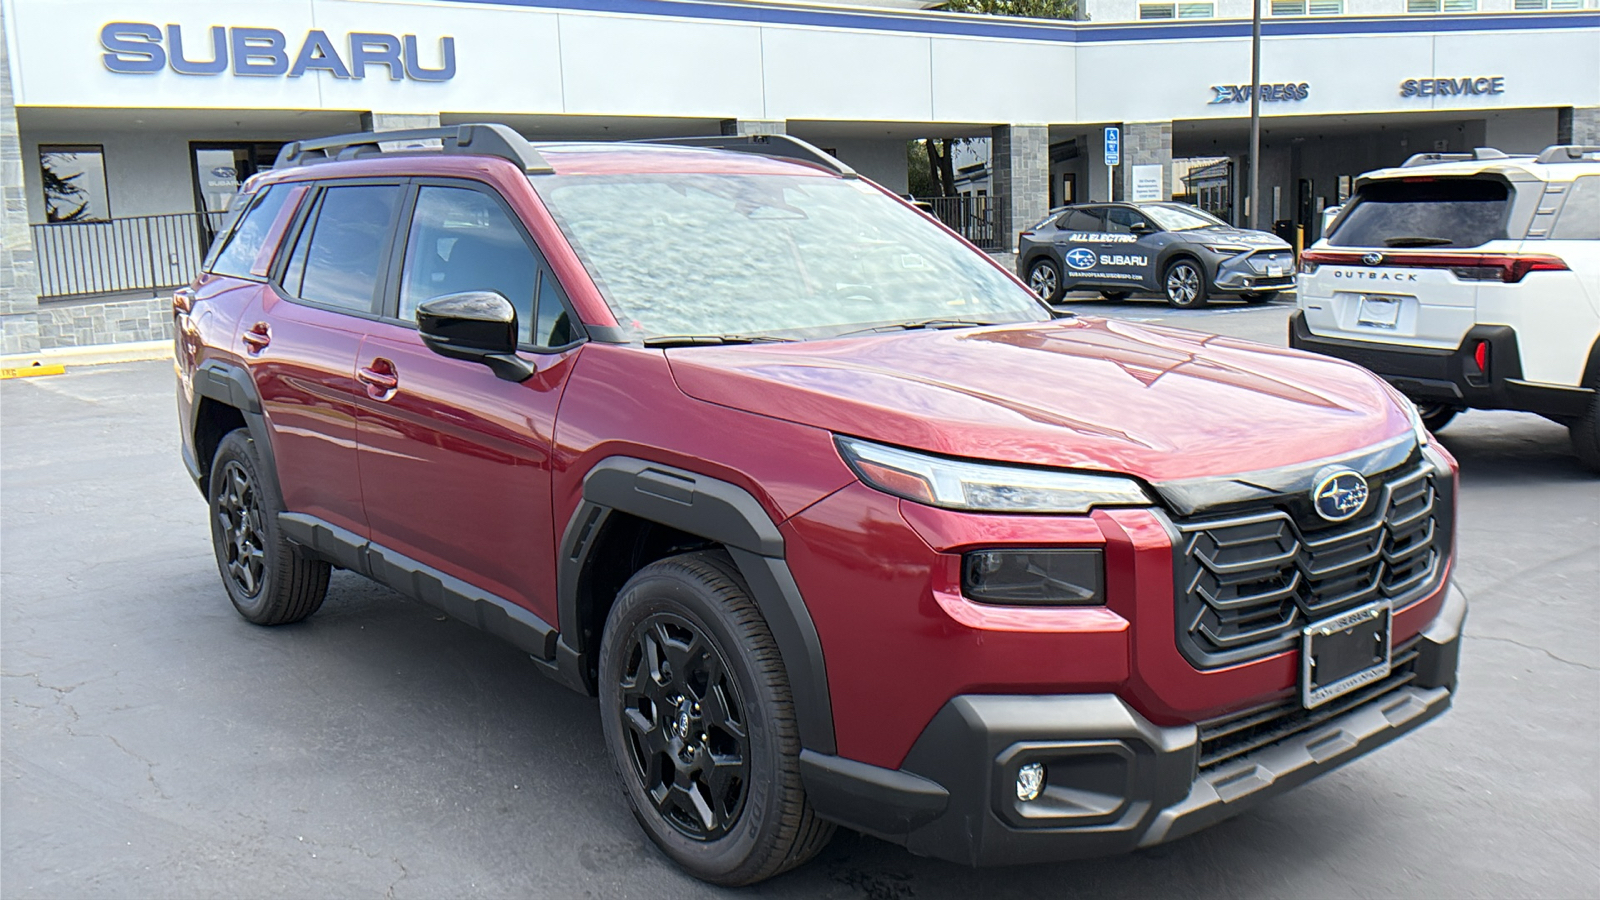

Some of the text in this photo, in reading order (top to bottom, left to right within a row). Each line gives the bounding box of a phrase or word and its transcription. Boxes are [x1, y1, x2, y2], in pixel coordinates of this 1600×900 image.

[100, 22, 456, 82] SUBARU
[1400, 77, 1504, 98] SERVICE
[1069, 233, 1138, 243] ALL ELECTRIC
[1100, 255, 1148, 266] SUBARU
[1334, 270, 1418, 282] OUTBACK
